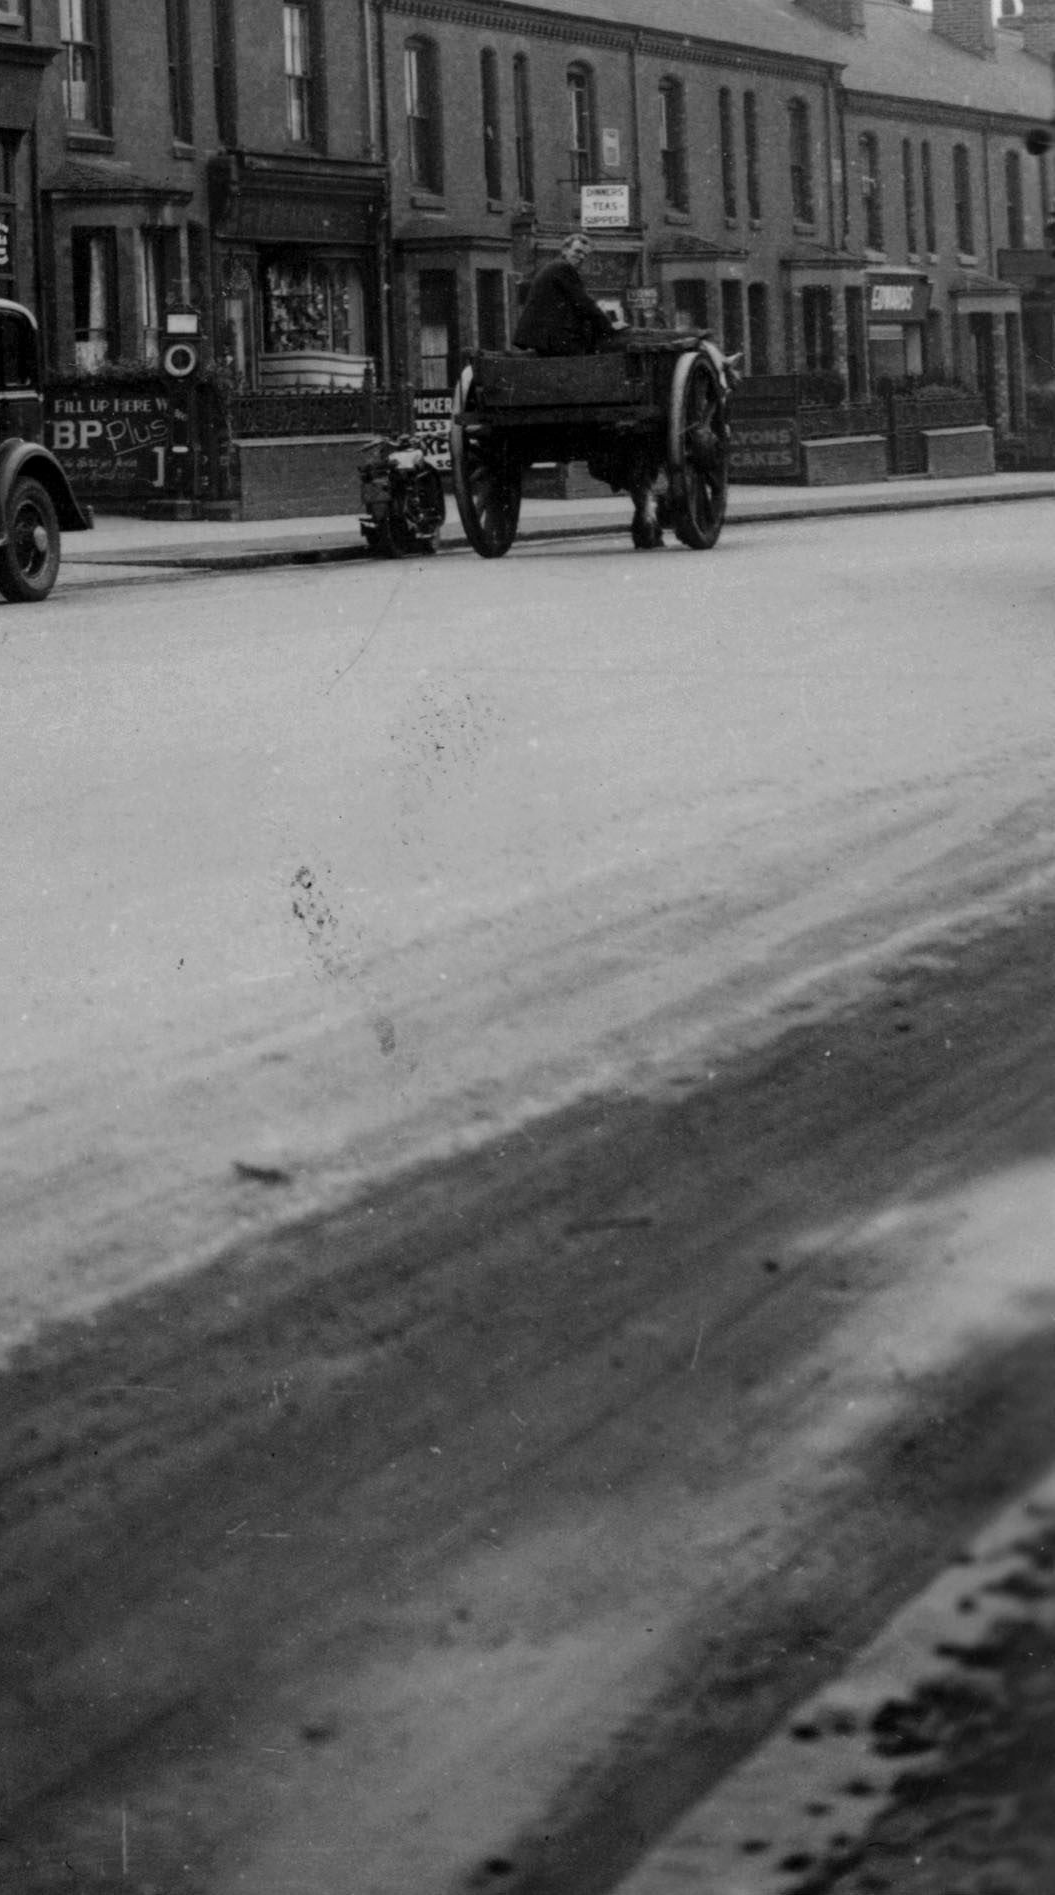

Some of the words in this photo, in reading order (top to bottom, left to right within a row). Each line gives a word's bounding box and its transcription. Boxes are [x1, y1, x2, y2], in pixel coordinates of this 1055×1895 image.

[54, 399, 85, 414] FILL
[89, 398, 109, 413] UP
[113, 397, 152, 413] HERE
[52, 420, 103, 450] BP
[106, 418, 168, 451] Plus
[729, 450, 793, 467] CAKES
